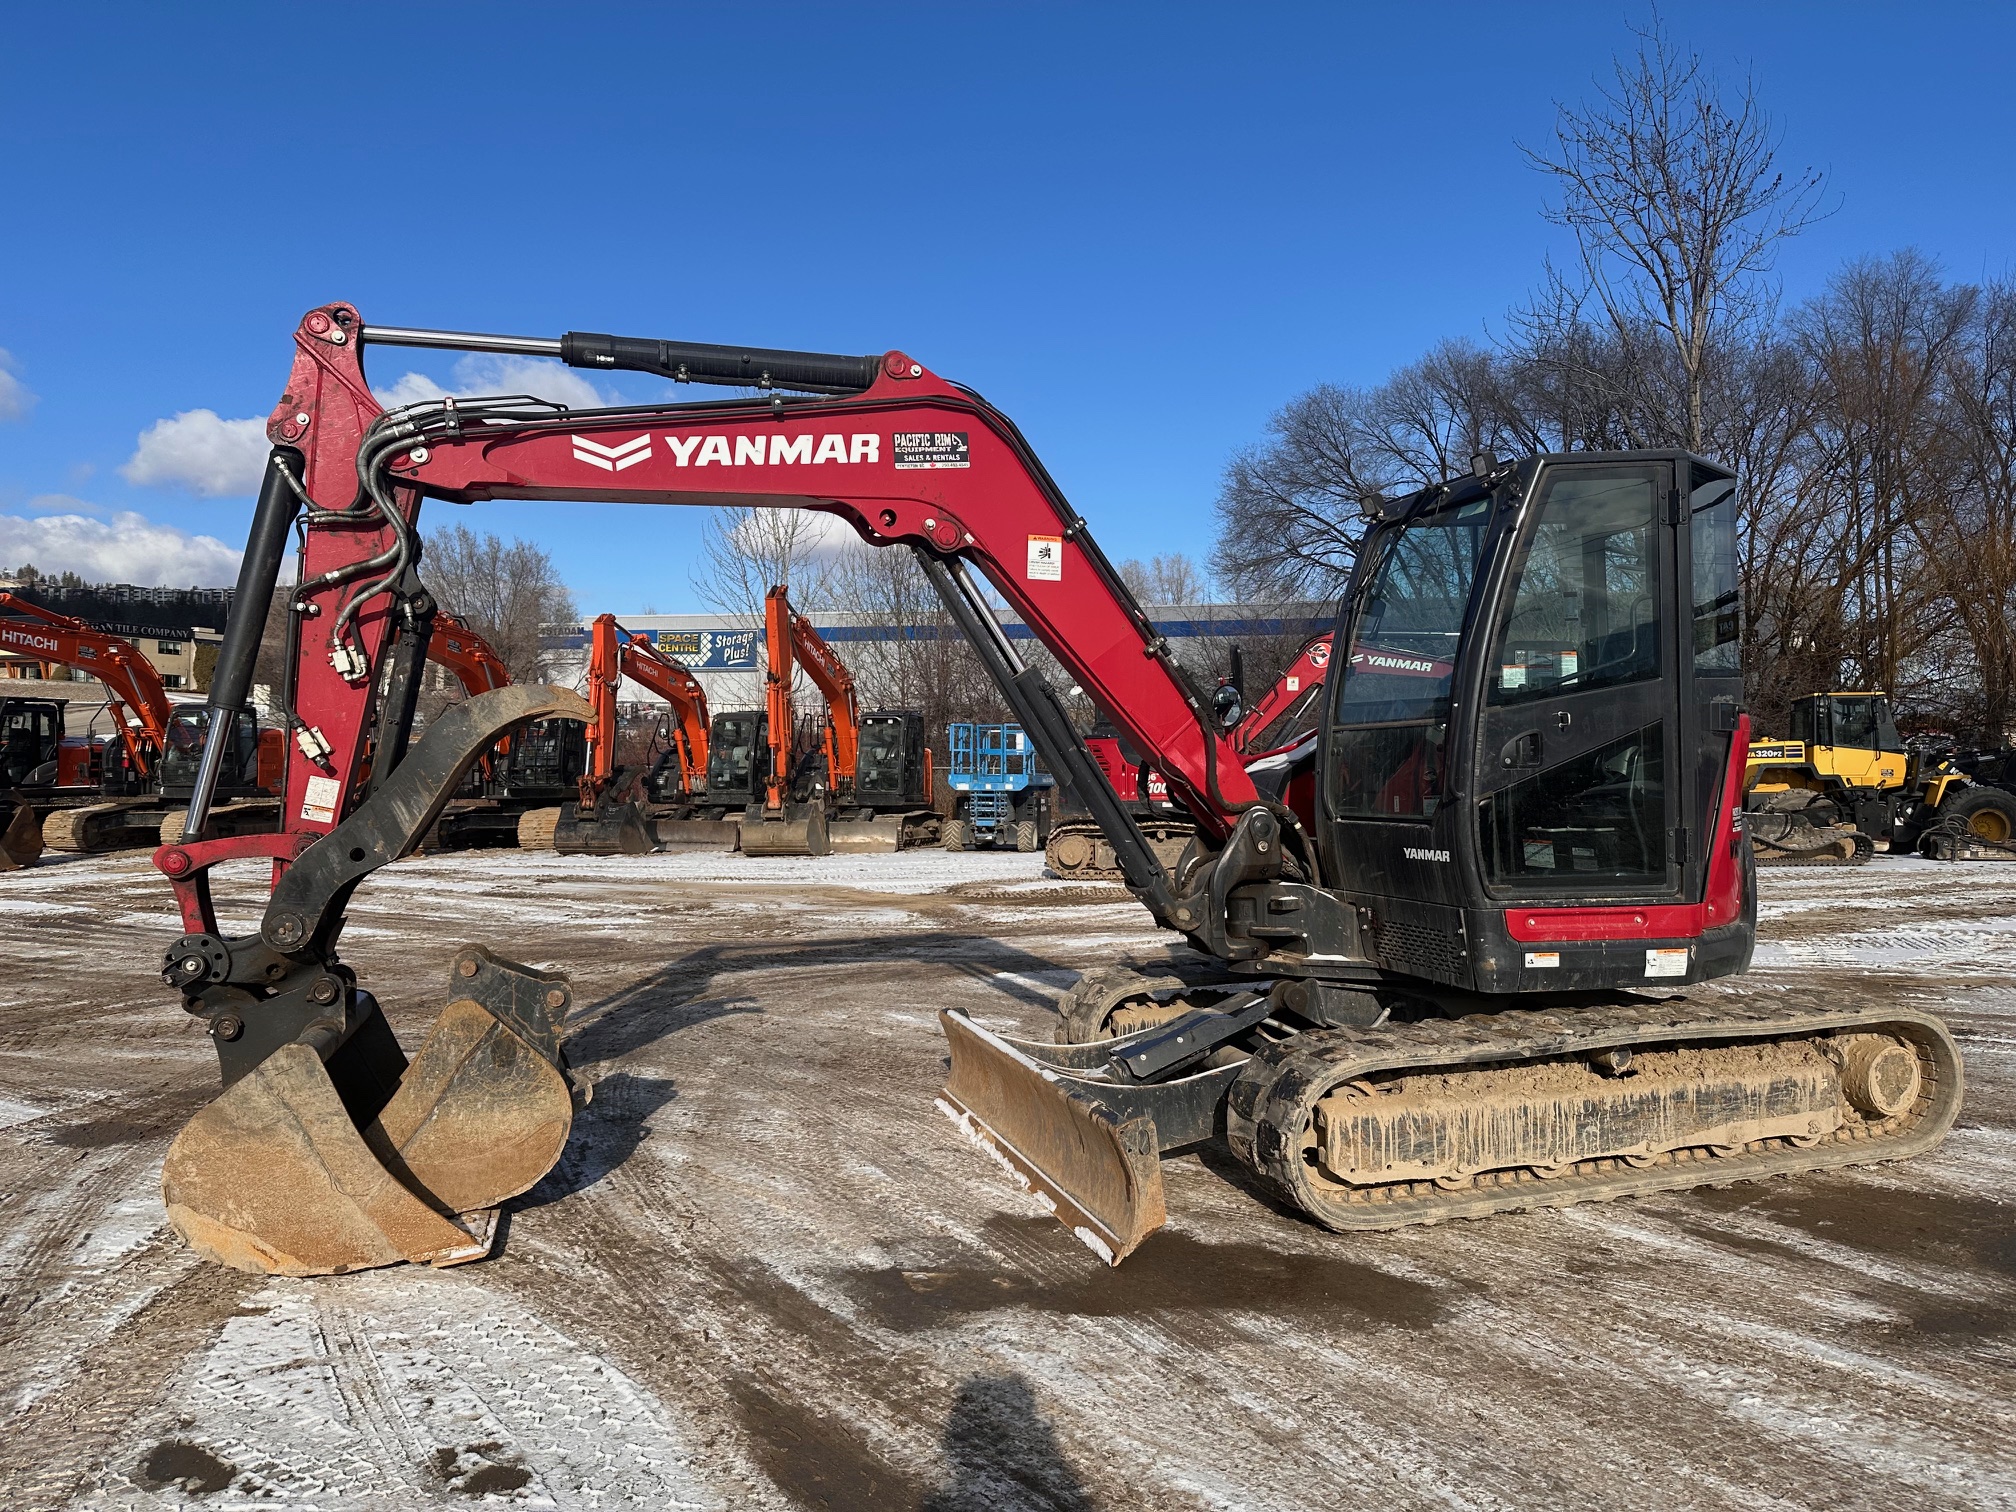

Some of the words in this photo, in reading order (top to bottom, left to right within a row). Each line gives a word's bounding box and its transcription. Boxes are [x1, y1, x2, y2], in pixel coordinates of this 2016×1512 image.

[894, 434, 930, 447] PACIFIC
[934, 434, 952, 446] RIM
[665, 433, 880, 467] YANMAR
[114, 624, 139, 634] TILE
[140, 626, 189, 638] COMPANY
[659, 633, 699, 643] SPACE
[1, 629, 58, 651] HITACHI
[658, 643, 699, 653] CENTRE
[715, 631, 754, 649] Storage
[723, 643, 750, 661] Plus!
[804, 639, 826, 667] HITACHI
[636, 661, 659, 678] HITACHI
[1367, 654, 1433, 672] YANMAR
[1403, 847, 1450, 862] YANMAR
